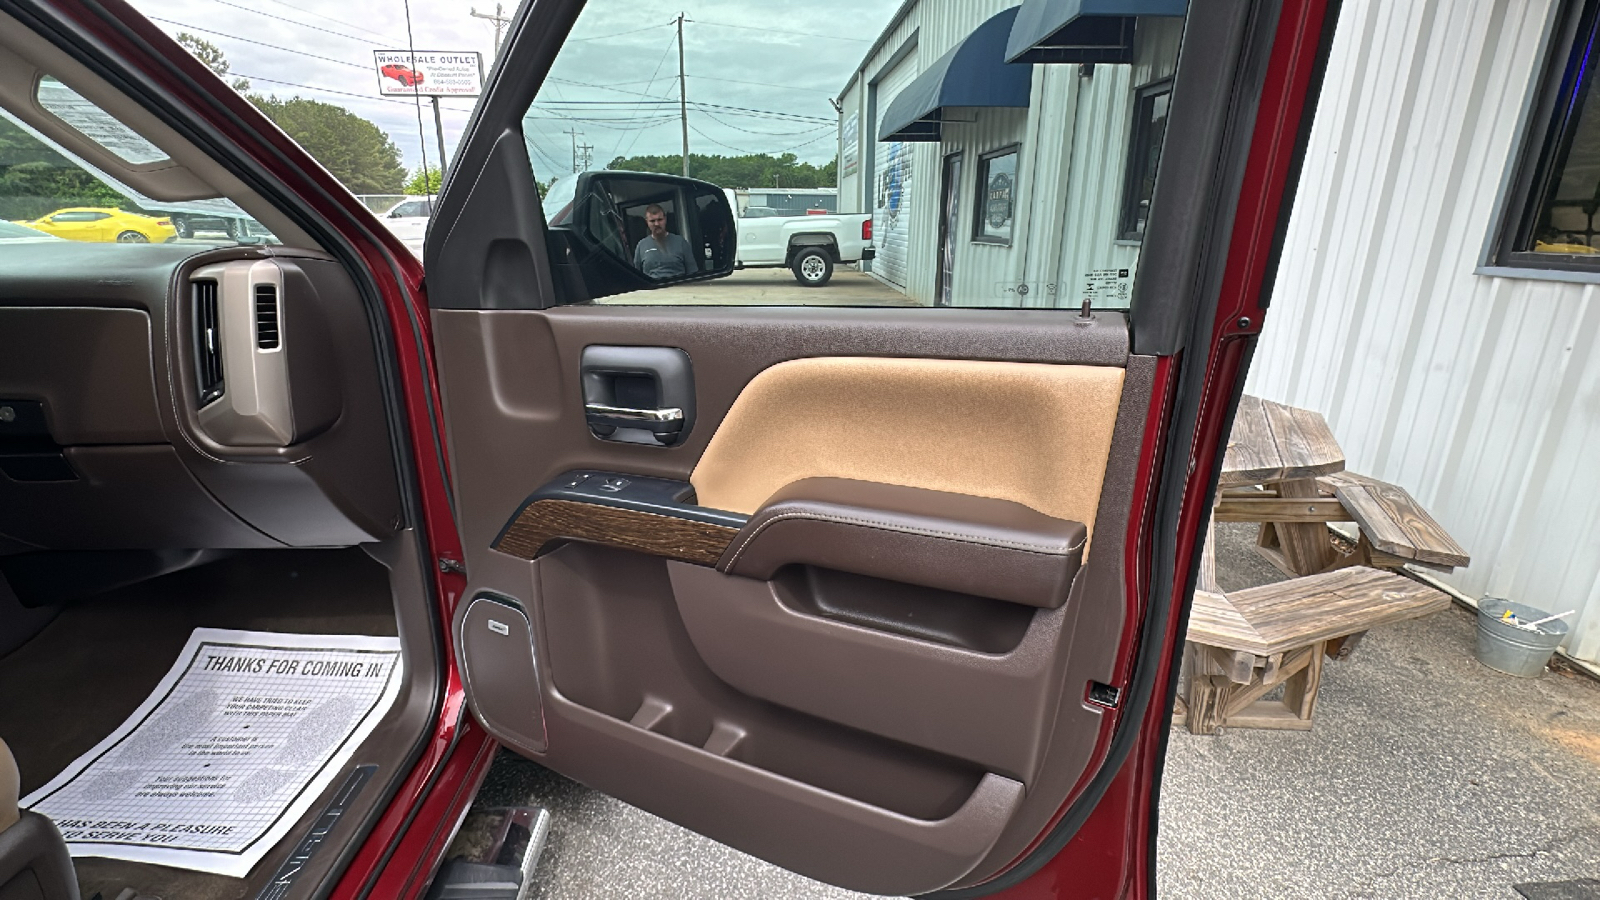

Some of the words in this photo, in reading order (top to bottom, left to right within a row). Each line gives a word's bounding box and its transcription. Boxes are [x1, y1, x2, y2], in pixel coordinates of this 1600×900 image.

[378, 56, 436, 64] WHOLESALE
[440, 56, 476, 64] OUTLET
[204, 656, 266, 674] THANKS
[265, 659, 300, 675] FOR
[301, 661, 364, 678] COMING
[364, 663, 384, 678] IN
[56, 819, 92, 829] HAS
[91, 820, 136, 830] BEEN
[136, 823, 149, 831] A
[149, 823, 238, 836] PLEASURE
[81, 831, 141, 841] SERVE
[141, 833, 178, 842] YOU
